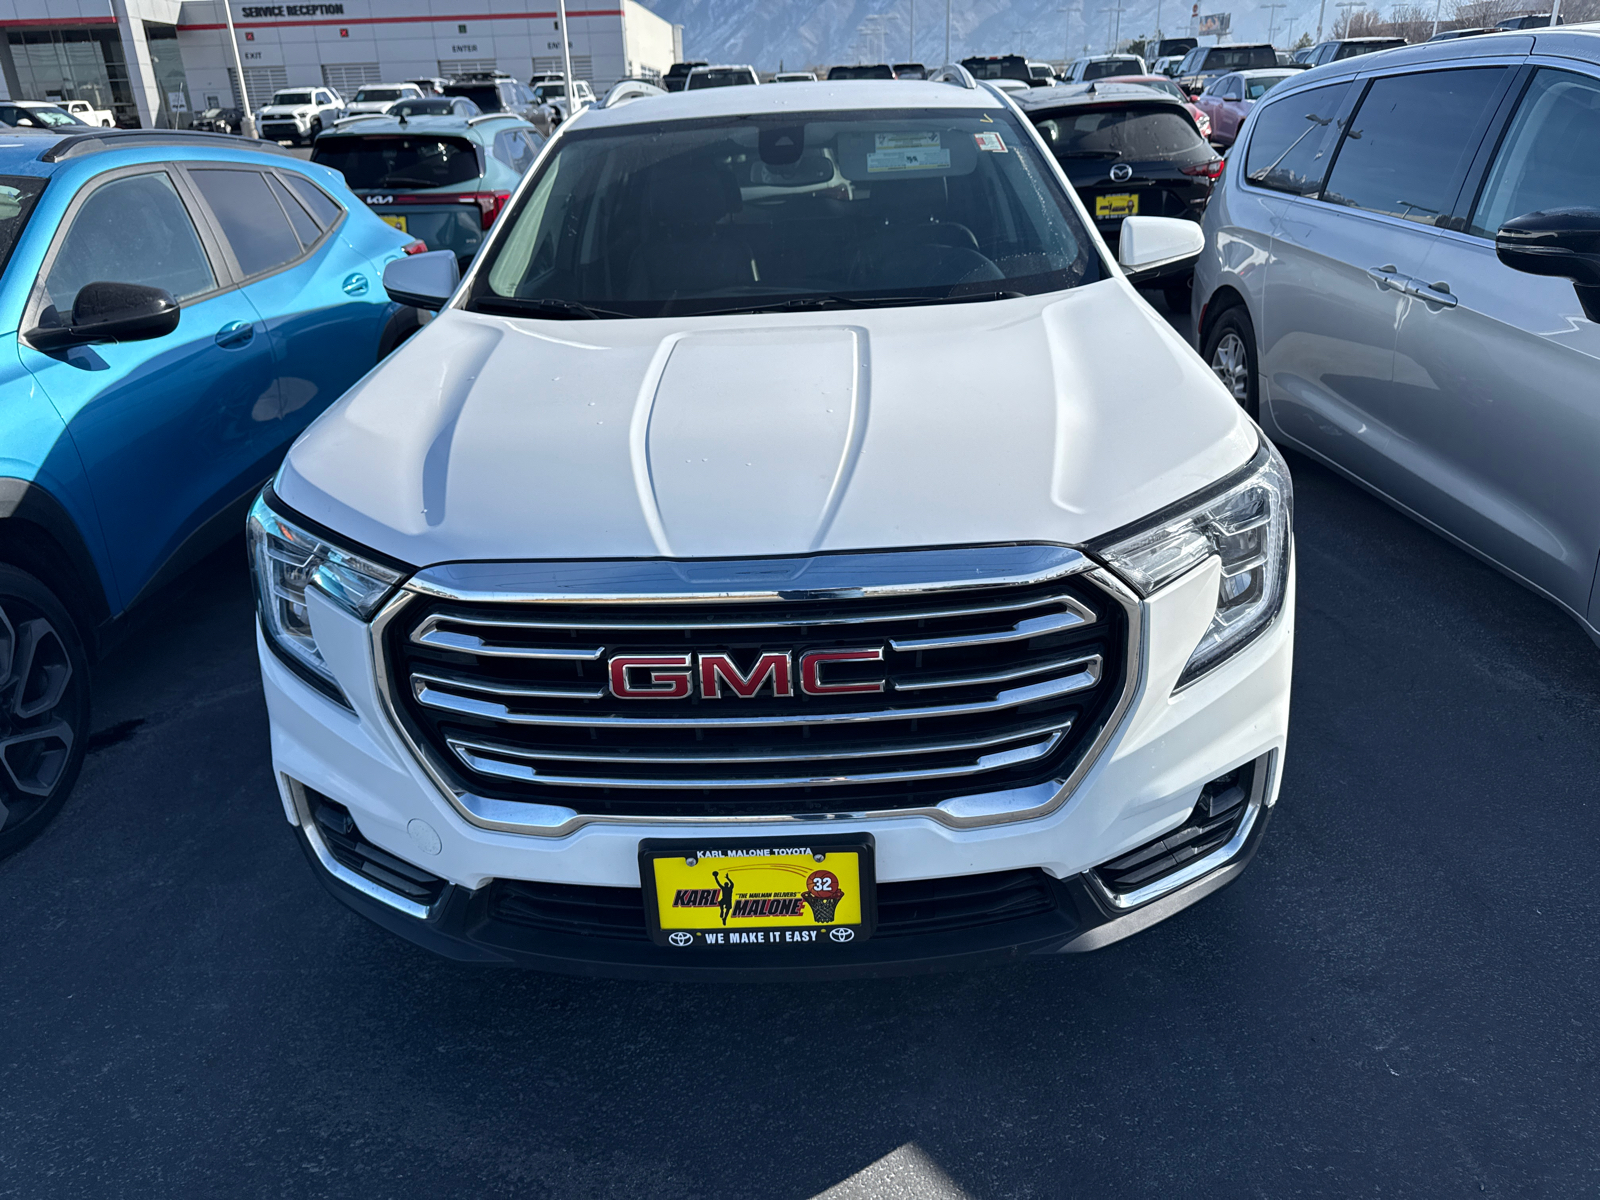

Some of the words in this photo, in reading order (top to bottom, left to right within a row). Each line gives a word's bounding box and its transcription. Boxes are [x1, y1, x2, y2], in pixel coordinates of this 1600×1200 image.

[242, 6, 285, 17] SERVICE
[286, 4, 344, 16] RECEPTION
[452, 44, 478, 53] ENTER
[245, 52, 262, 60] EXIT
[366, 195, 394, 204] KIA
[608, 646, 885, 699] GMC
[697, 850, 725, 859] KARL
[727, 848, 771, 858] MALONE
[773, 847, 813, 856] TOYOTA
[812, 877, 832, 892] 32
[672, 888, 721, 907] KARL
[731, 898, 805, 918] MALONE
[705, 933, 725, 944] WE
[729, 932, 765, 944] MAKE
[769, 931, 781, 943] IT
[785, 930, 817, 942] EASY
